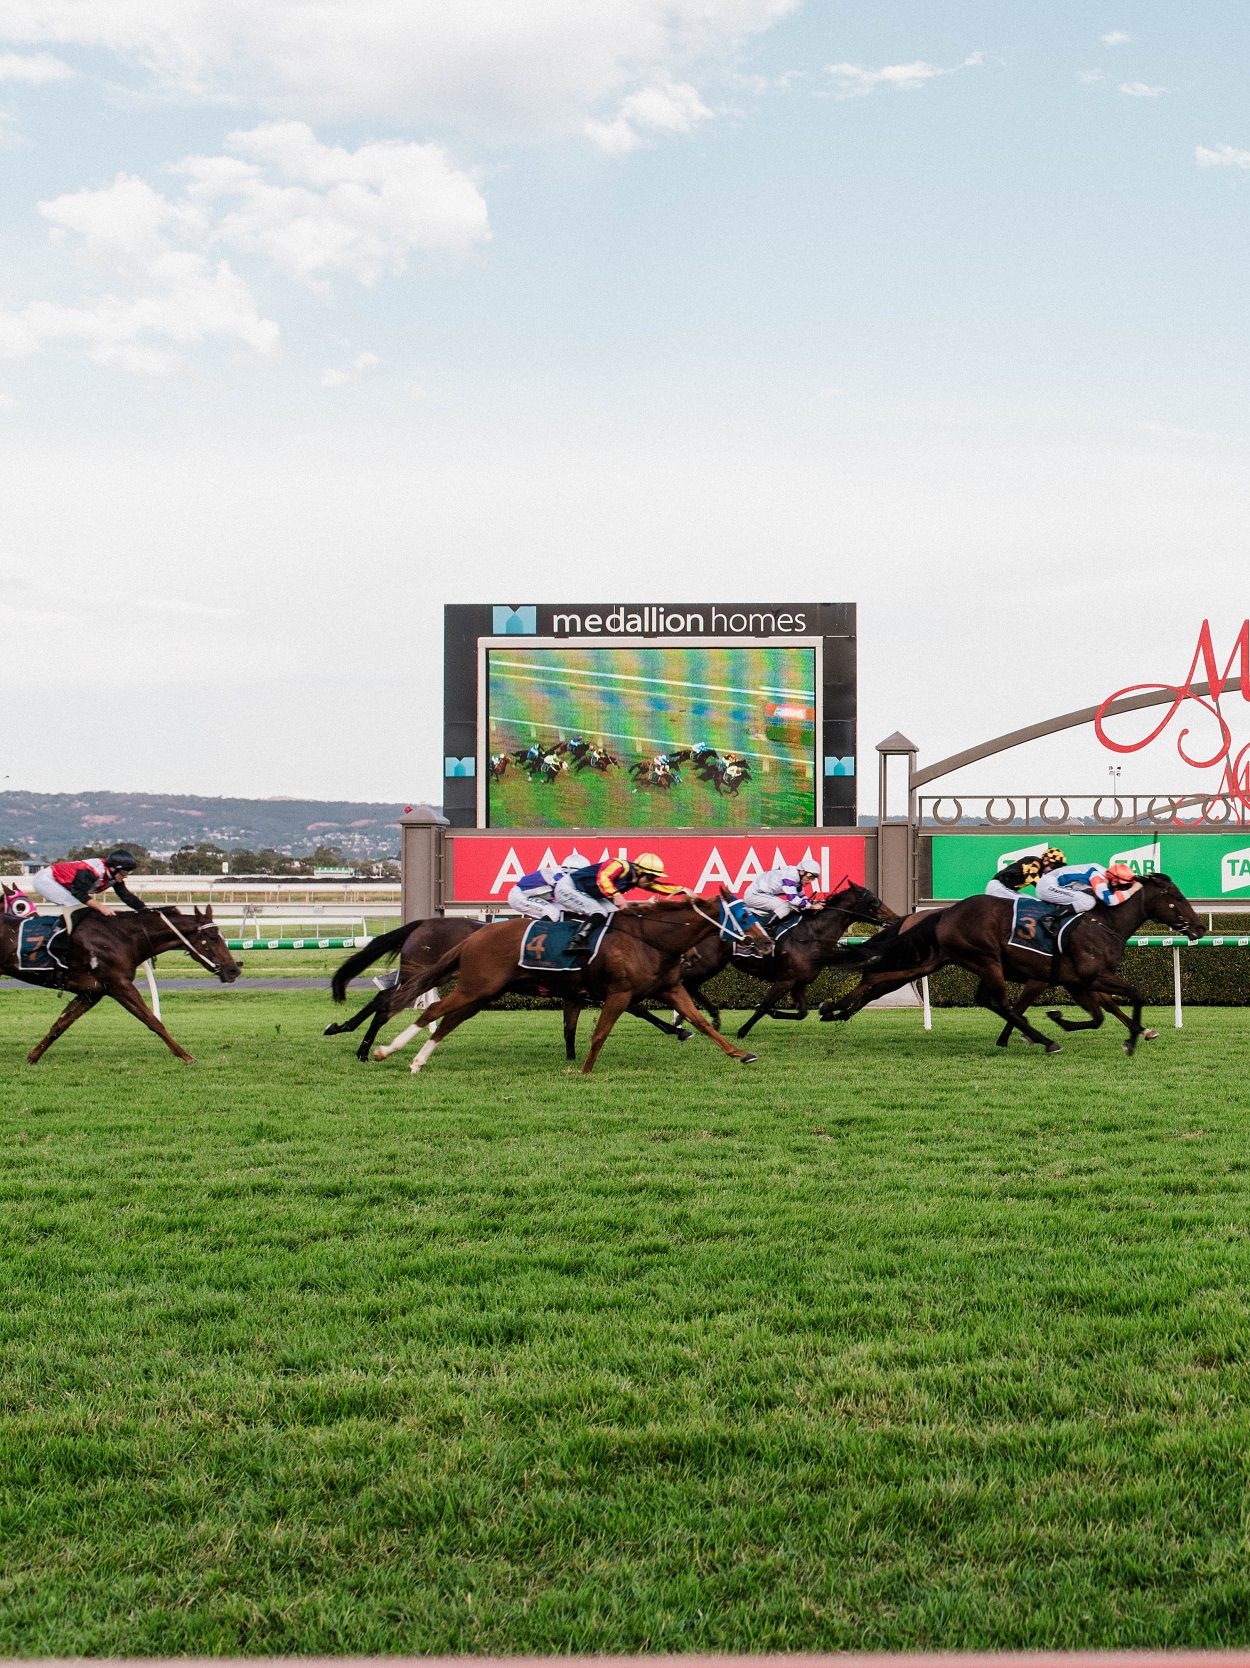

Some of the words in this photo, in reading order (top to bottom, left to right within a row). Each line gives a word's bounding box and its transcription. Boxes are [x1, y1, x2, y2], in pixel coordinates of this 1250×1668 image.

[553, 606, 704, 633] medallion
[711, 606, 807, 633] homes
[1017, 916, 1037, 940] 3
[26, 935, 45, 961] 7
[526, 933, 548, 960] 4
